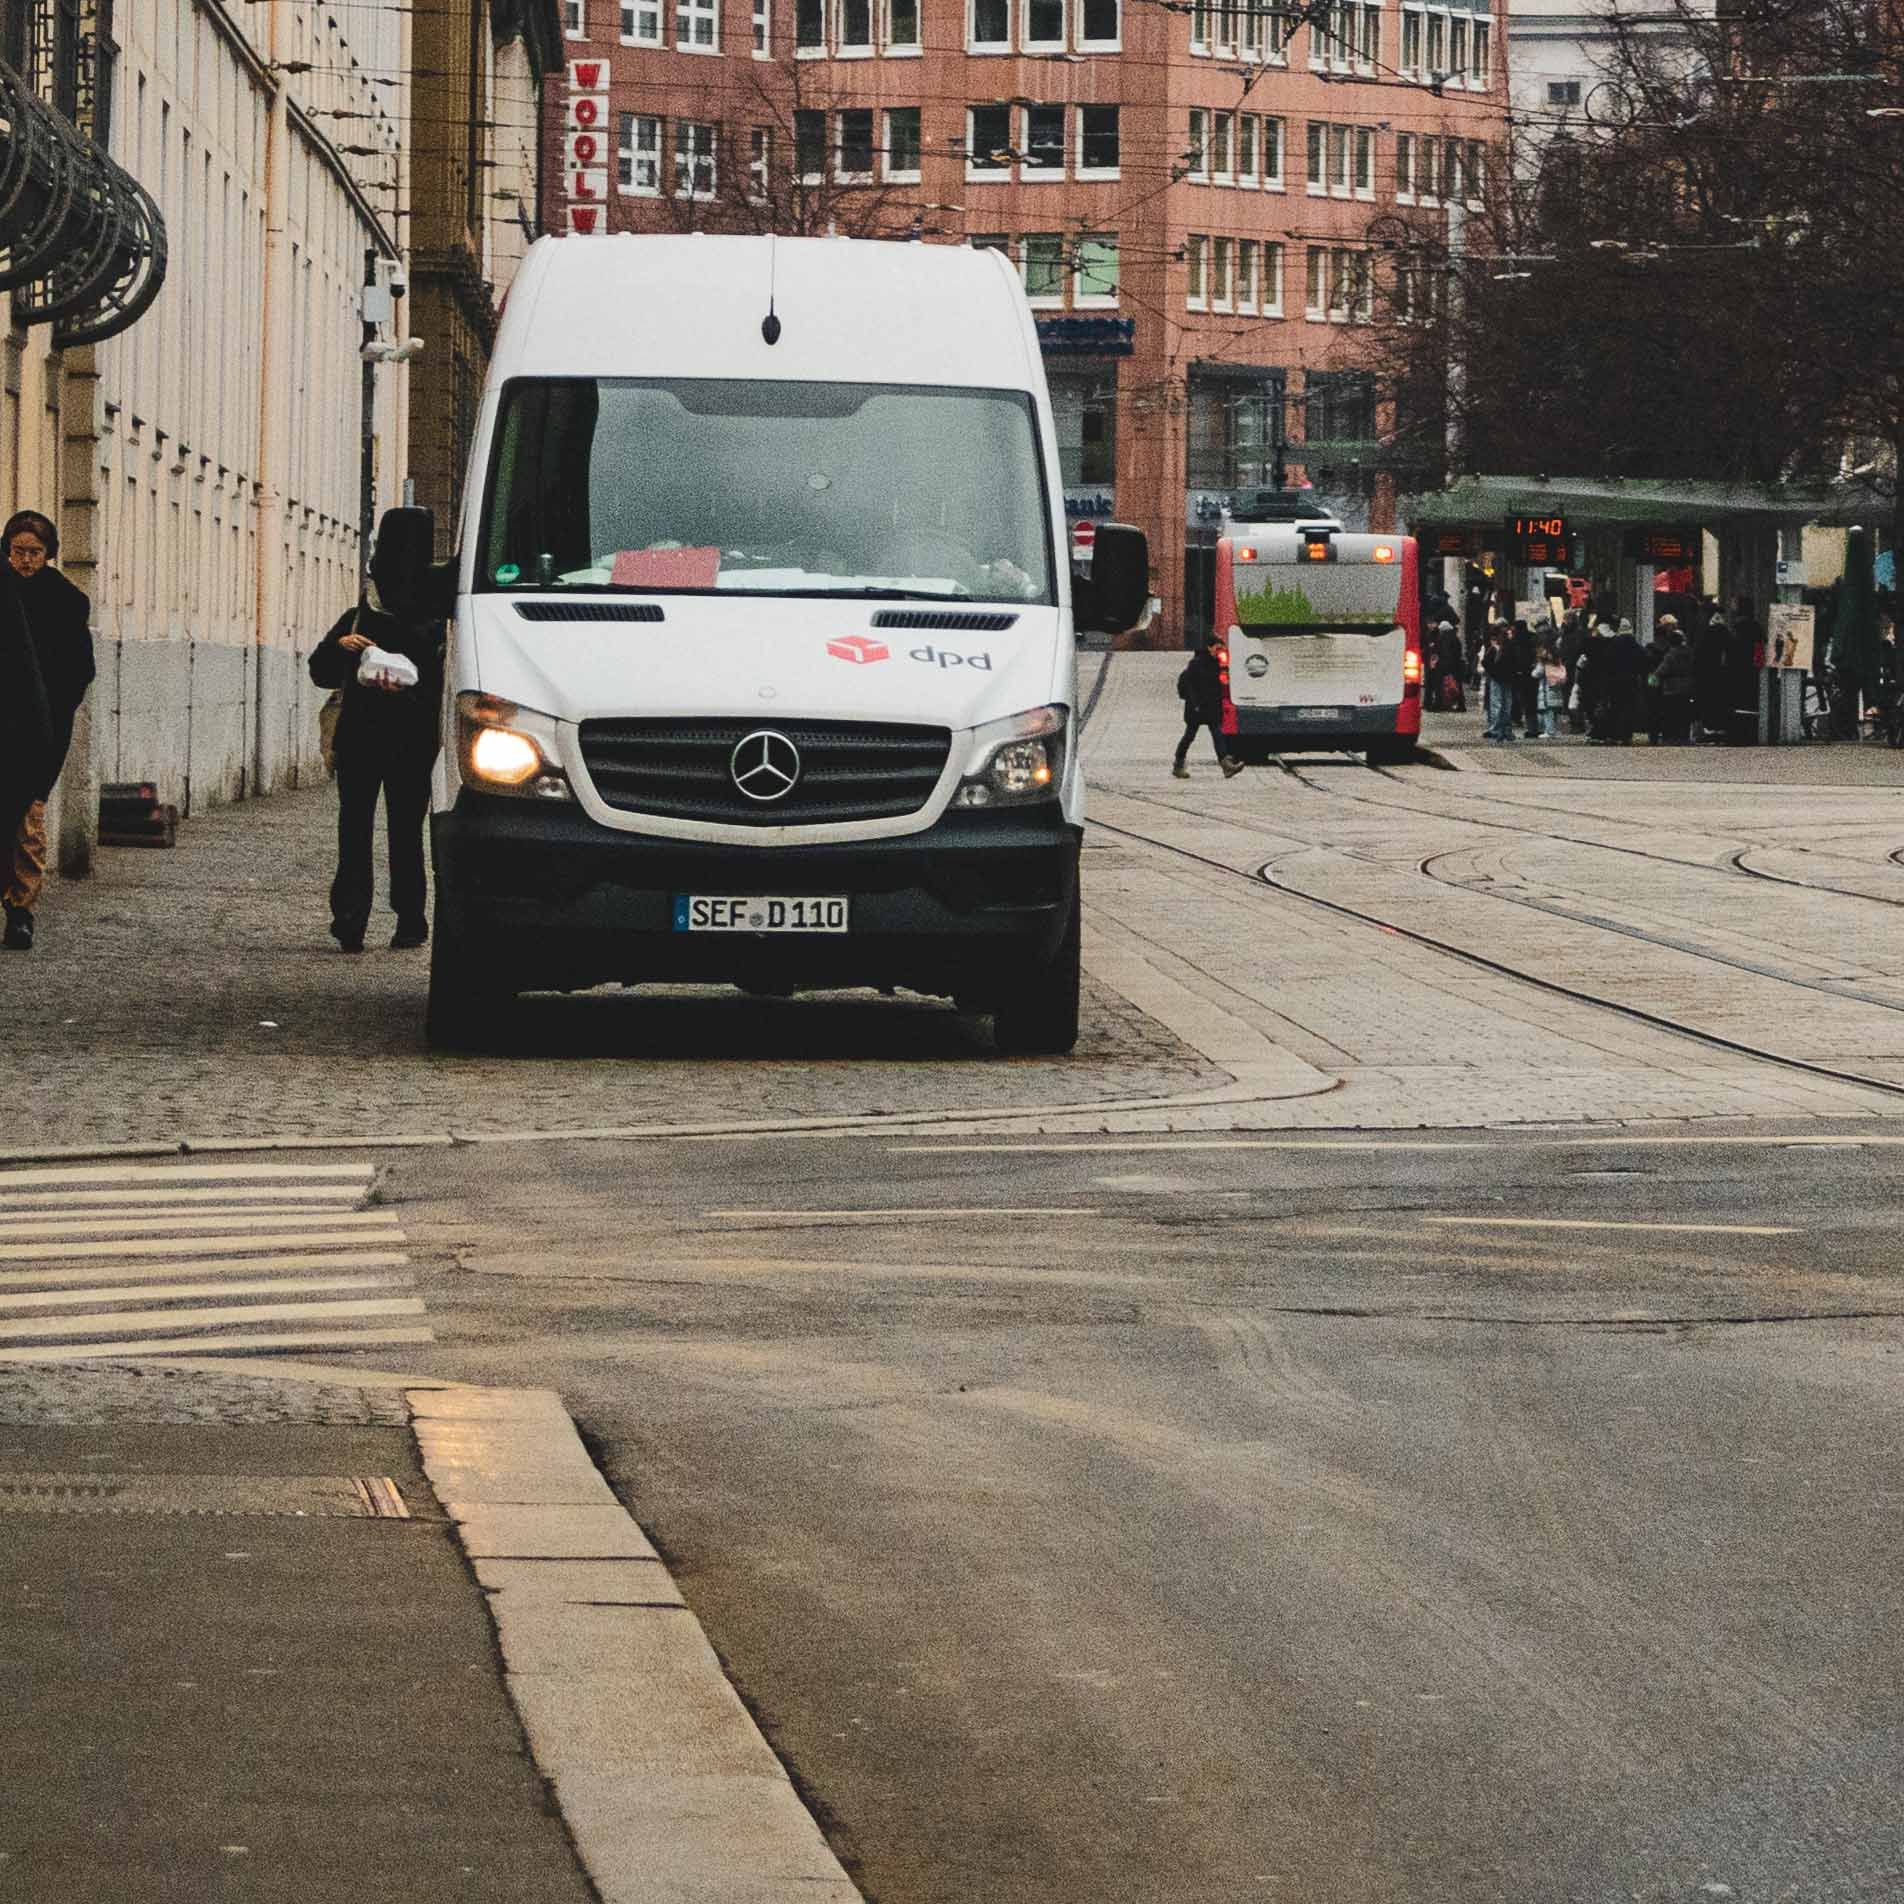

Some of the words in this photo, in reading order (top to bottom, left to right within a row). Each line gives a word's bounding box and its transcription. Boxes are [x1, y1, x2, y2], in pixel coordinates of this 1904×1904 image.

[1516, 519, 1563, 536] 11:40
[910, 645, 992, 671] dpd
[692, 900, 748, 927] SEF
